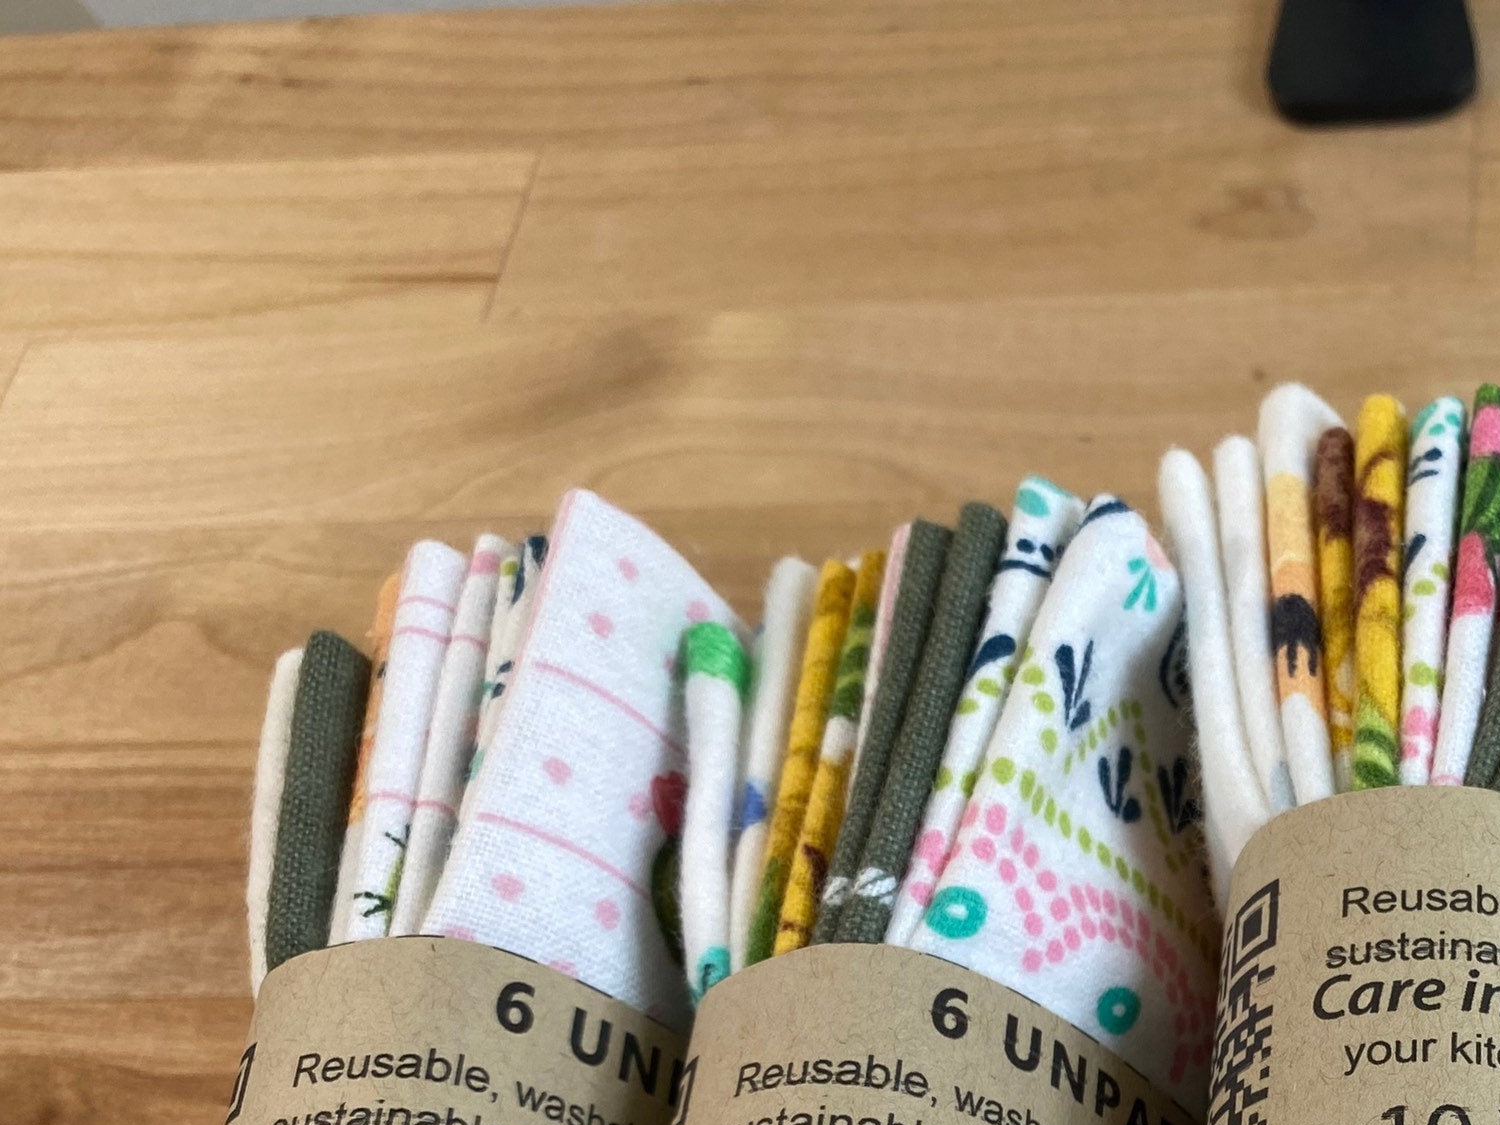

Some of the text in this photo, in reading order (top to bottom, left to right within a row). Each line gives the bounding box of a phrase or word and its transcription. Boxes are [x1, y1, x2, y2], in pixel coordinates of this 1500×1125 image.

[496, 981, 536, 1034] 6
[931, 986, 969, 1040] 6
[1312, 971, 1446, 1021] Care
[292, 1048, 499, 1102] Reusable,
[734, 1054, 938, 1107] Reusable,
[1343, 1033, 1438, 1077] your
